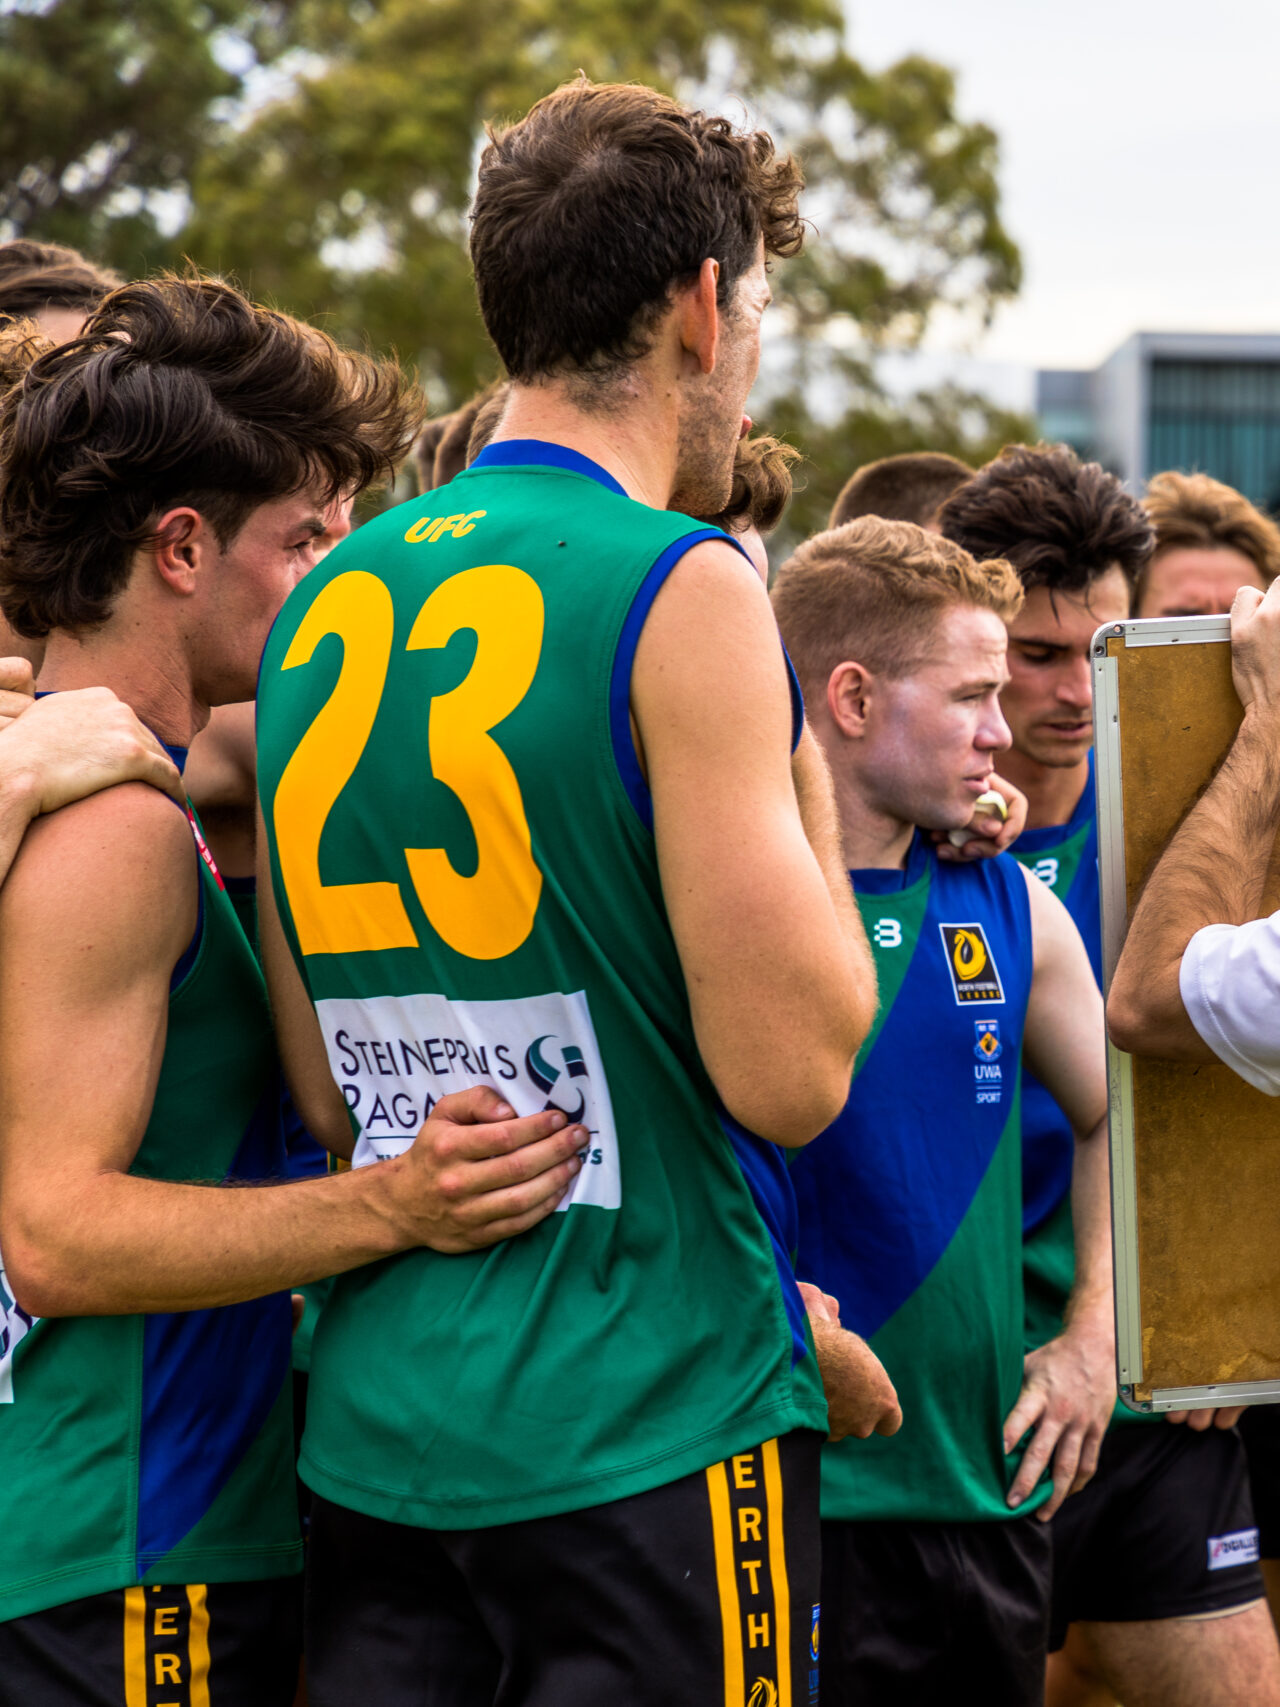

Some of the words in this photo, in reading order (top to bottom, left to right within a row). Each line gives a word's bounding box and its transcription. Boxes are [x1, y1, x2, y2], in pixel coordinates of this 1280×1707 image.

[404, 510, 487, 544] UFC
[273, 564, 546, 961] 23
[974, 1064, 1002, 1080] UWA
[976, 1092, 1002, 1104] SPORT
[731, 1453, 770, 1649] ERTH
